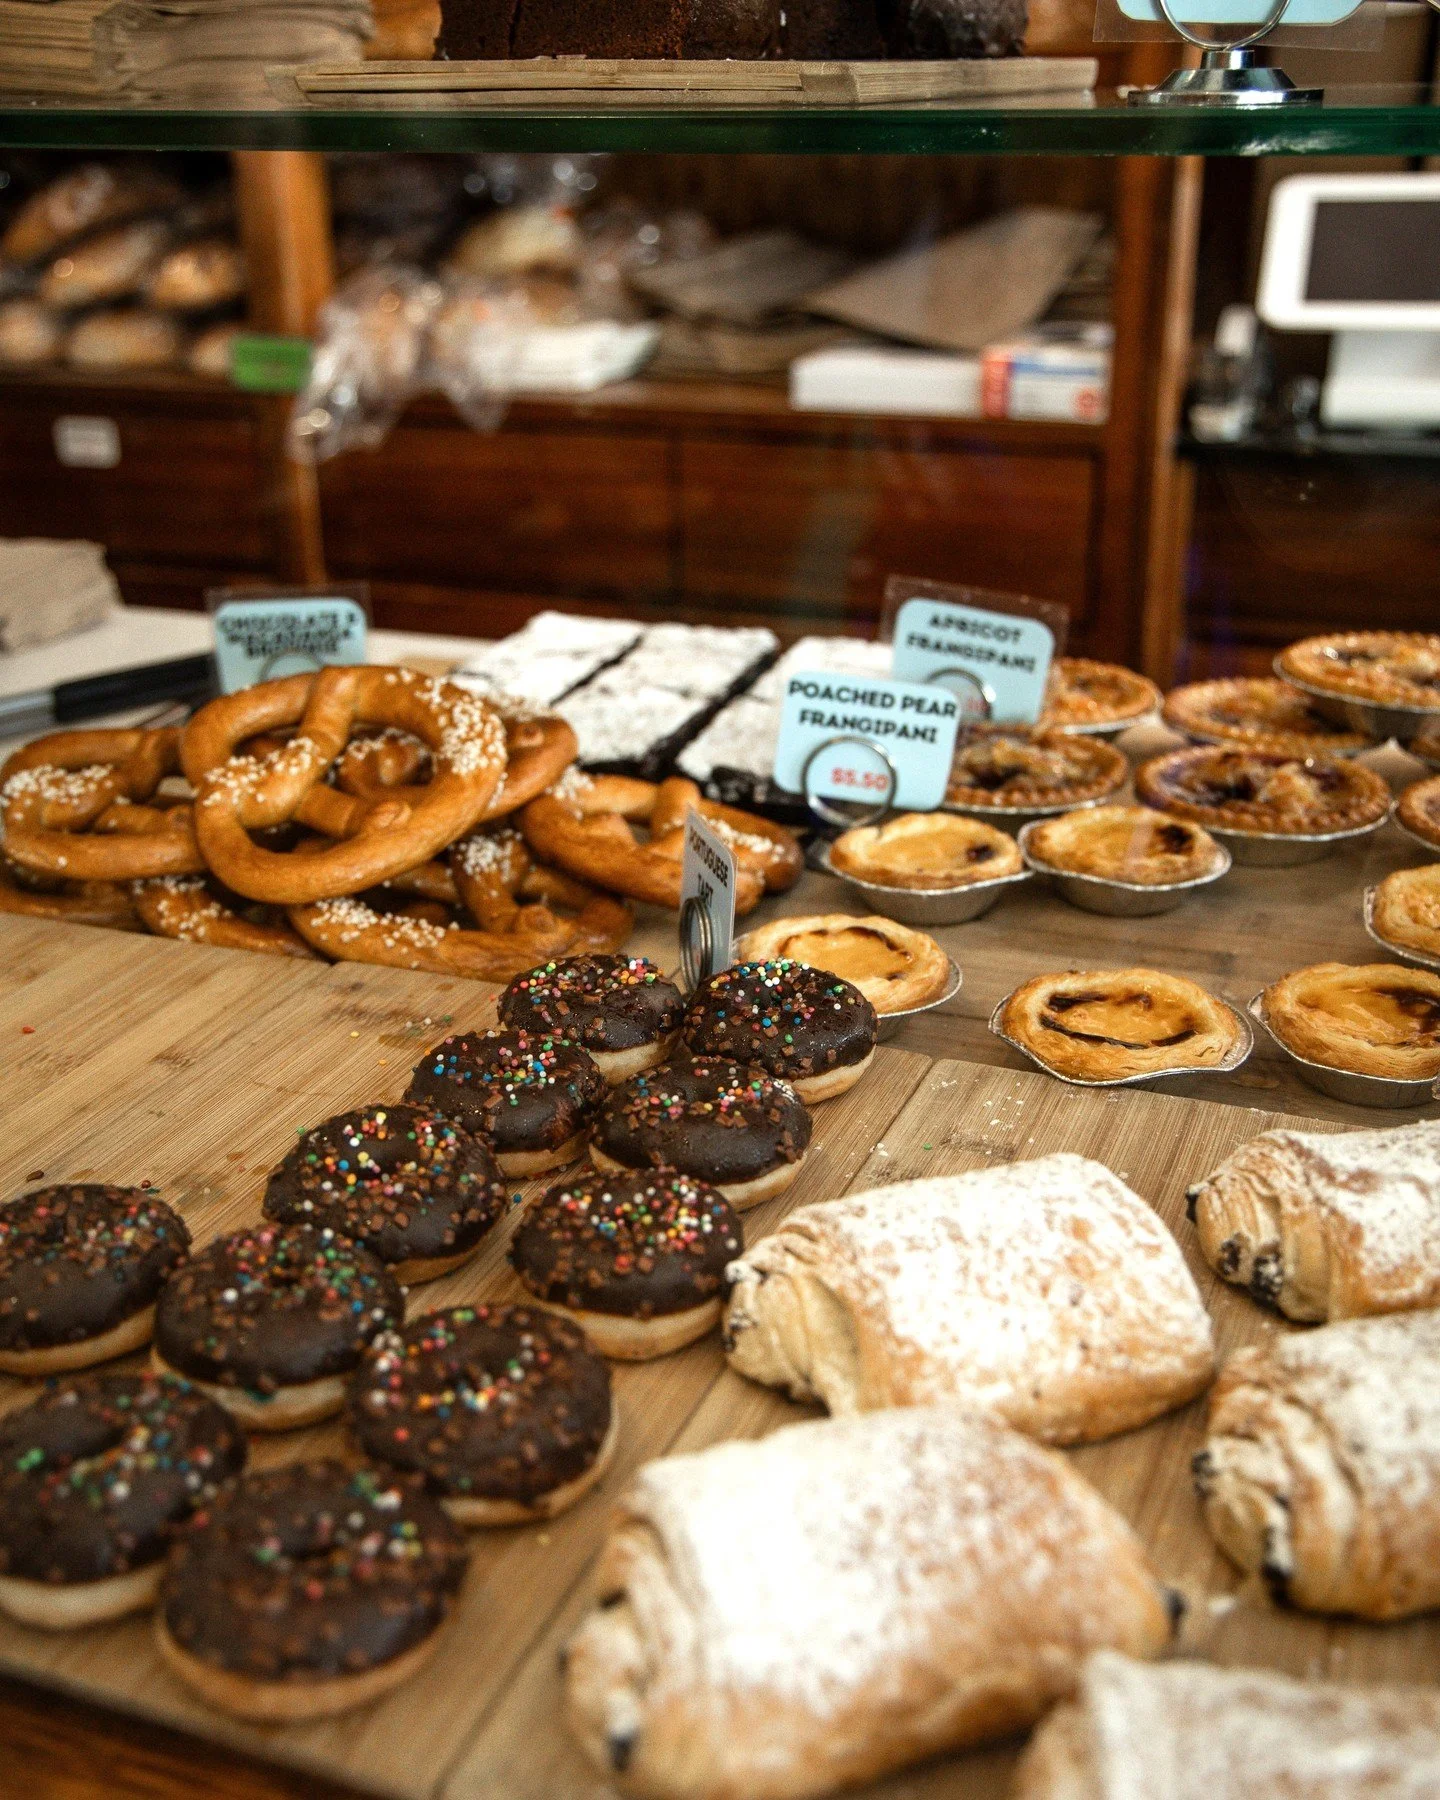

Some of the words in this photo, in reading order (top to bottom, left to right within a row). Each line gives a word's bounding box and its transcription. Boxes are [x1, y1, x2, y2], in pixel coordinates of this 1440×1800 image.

[929, 613, 1023, 645] APRICOT
[906, 632, 1036, 674] FRANGIPANI
[788, 679, 896, 709] POACHED
[901, 695, 957, 718] PEAR
[798, 708, 938, 744] FRANGIPANI
[831, 766, 889, 792] $5.50
[688, 825, 730, 888] PORTUGUESE
[697, 872, 714, 909] TART
